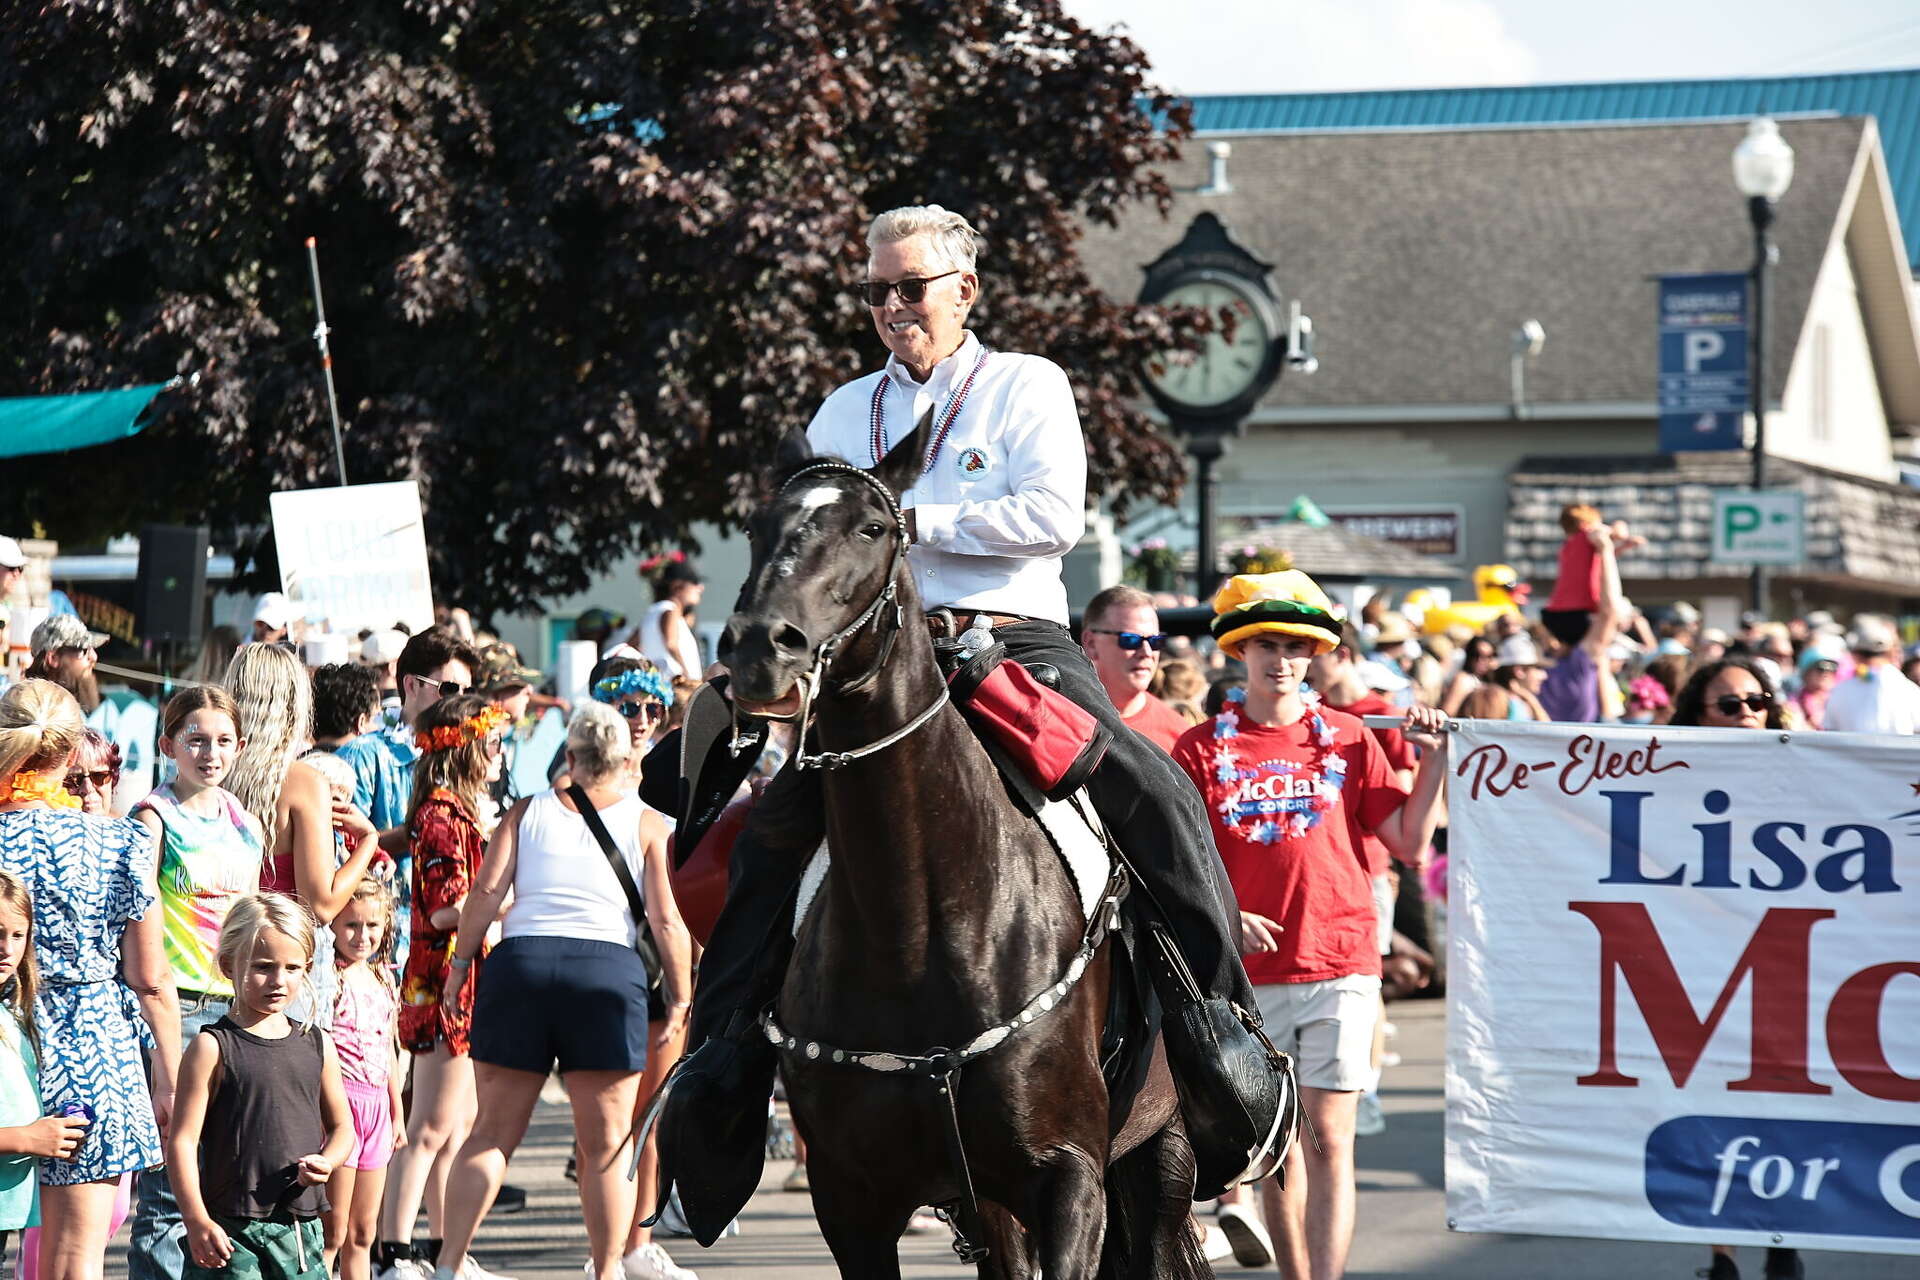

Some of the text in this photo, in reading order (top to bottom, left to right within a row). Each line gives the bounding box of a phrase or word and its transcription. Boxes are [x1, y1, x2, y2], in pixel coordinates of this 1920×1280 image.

[1684, 331, 1725, 375] P
[1724, 504, 1761, 552] P
[1238, 771, 1323, 803] McClai
[1457, 734, 1690, 801] Re-Elect
[1597, 789, 1903, 894] Lisa
[1710, 1135, 1841, 1217] for
